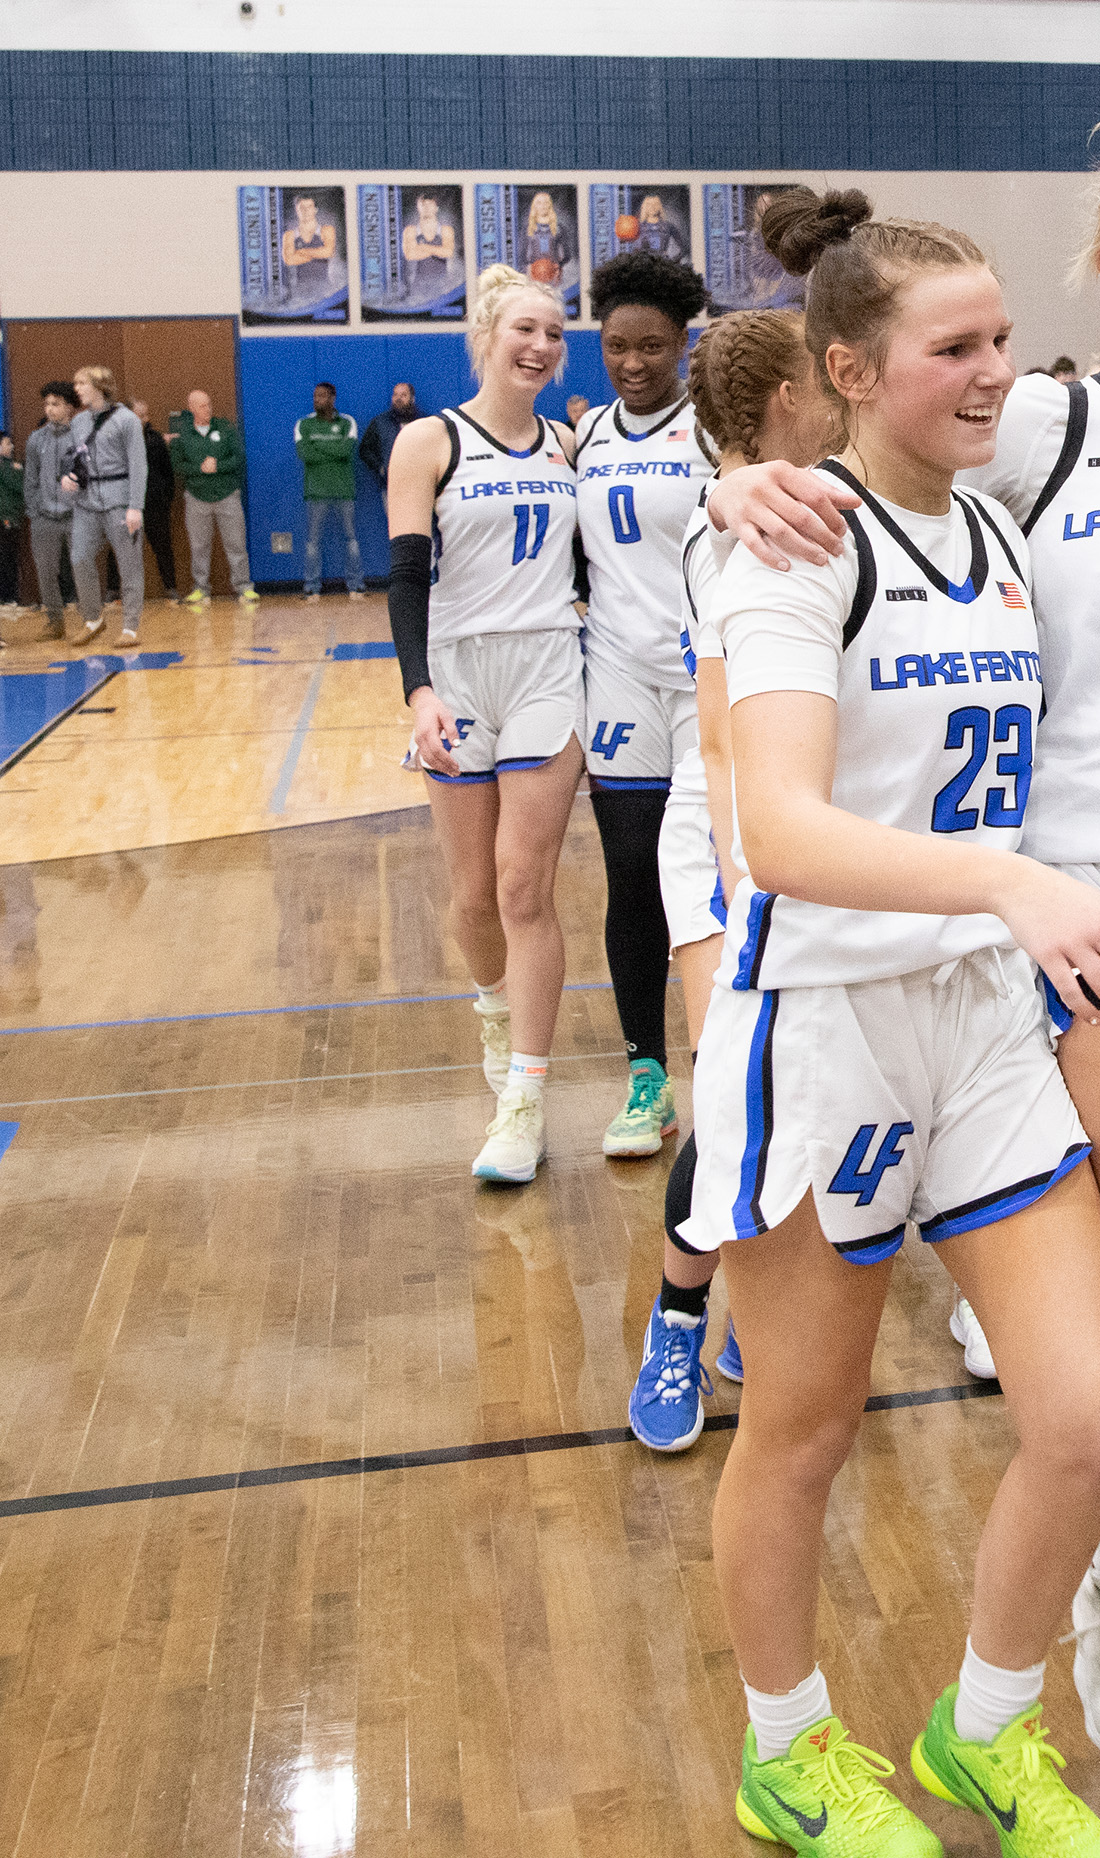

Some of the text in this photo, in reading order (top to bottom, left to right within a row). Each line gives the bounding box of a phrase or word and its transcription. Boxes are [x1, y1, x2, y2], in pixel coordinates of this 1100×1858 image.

[365, 193, 380, 264] JOHNSON
[481, 196, 496, 234] SISK
[248, 257, 264, 296] JACK
[615, 461, 691, 478] FENTON
[460, 481, 577, 500] LAKE FENTO
[512, 503, 550, 565] 11
[608, 485, 642, 544] 0
[870, 650, 1043, 691] LAKE FENTO
[590, 720, 636, 760] LF
[931, 704, 1033, 832] 23
[826, 1120, 915, 1208] LF
